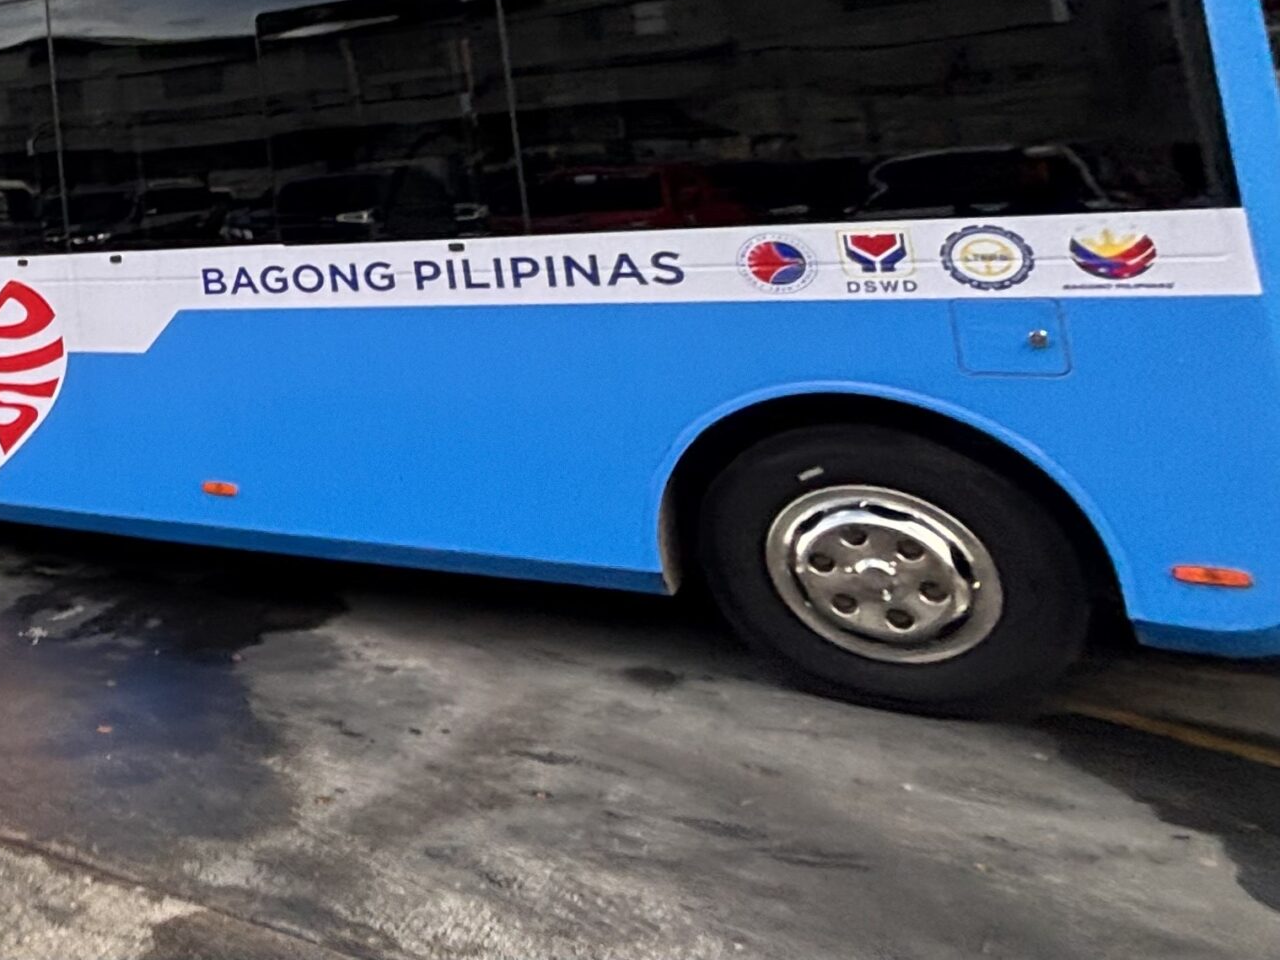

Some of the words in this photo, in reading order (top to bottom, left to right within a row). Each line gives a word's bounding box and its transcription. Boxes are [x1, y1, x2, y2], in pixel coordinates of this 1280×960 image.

[202, 262, 396, 296] BAGONG
[414, 251, 685, 291] PILIPINAS
[847, 279, 918, 294] DSWD
